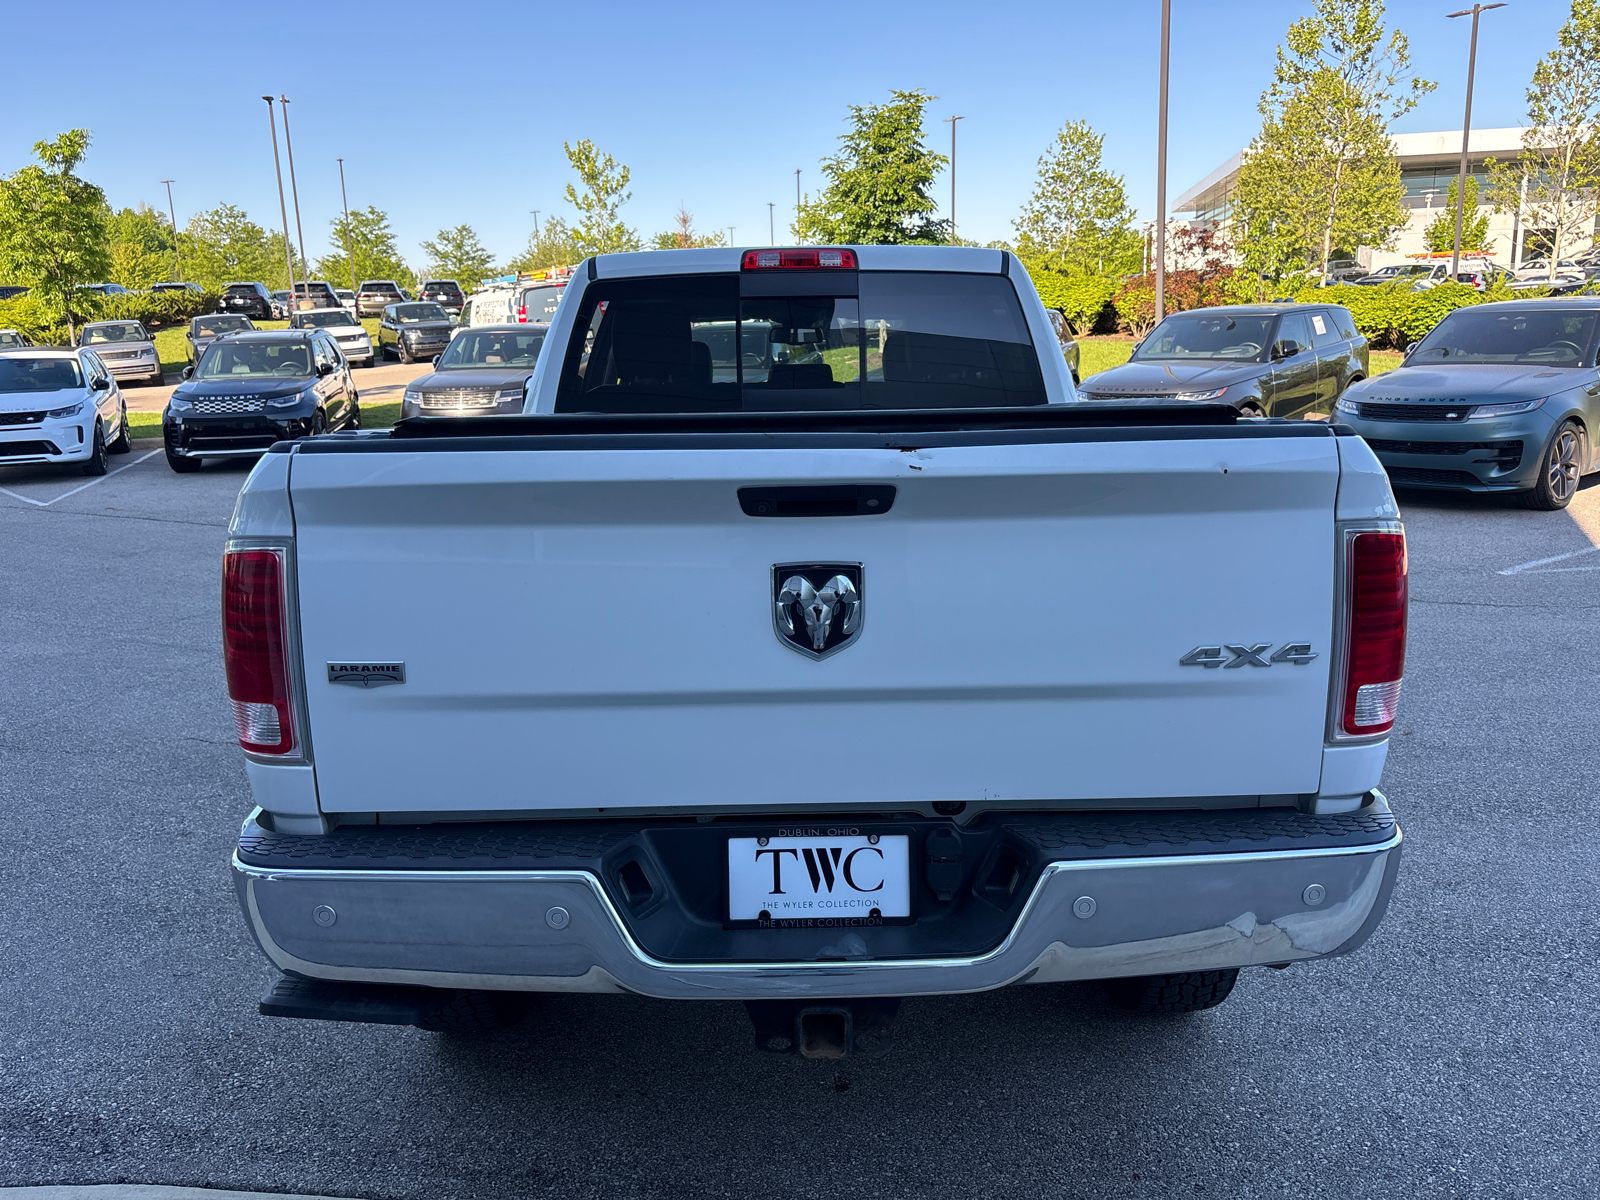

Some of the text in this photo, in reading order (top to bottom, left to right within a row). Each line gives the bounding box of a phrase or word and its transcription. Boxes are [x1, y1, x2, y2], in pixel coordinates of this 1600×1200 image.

[827, 827, 860, 836] OHIO
[755, 847, 885, 895] TWC
[762, 899, 879, 909] THE WYLER COLLECTION
[758, 918, 883, 928] THE WYLER COLLECTION
